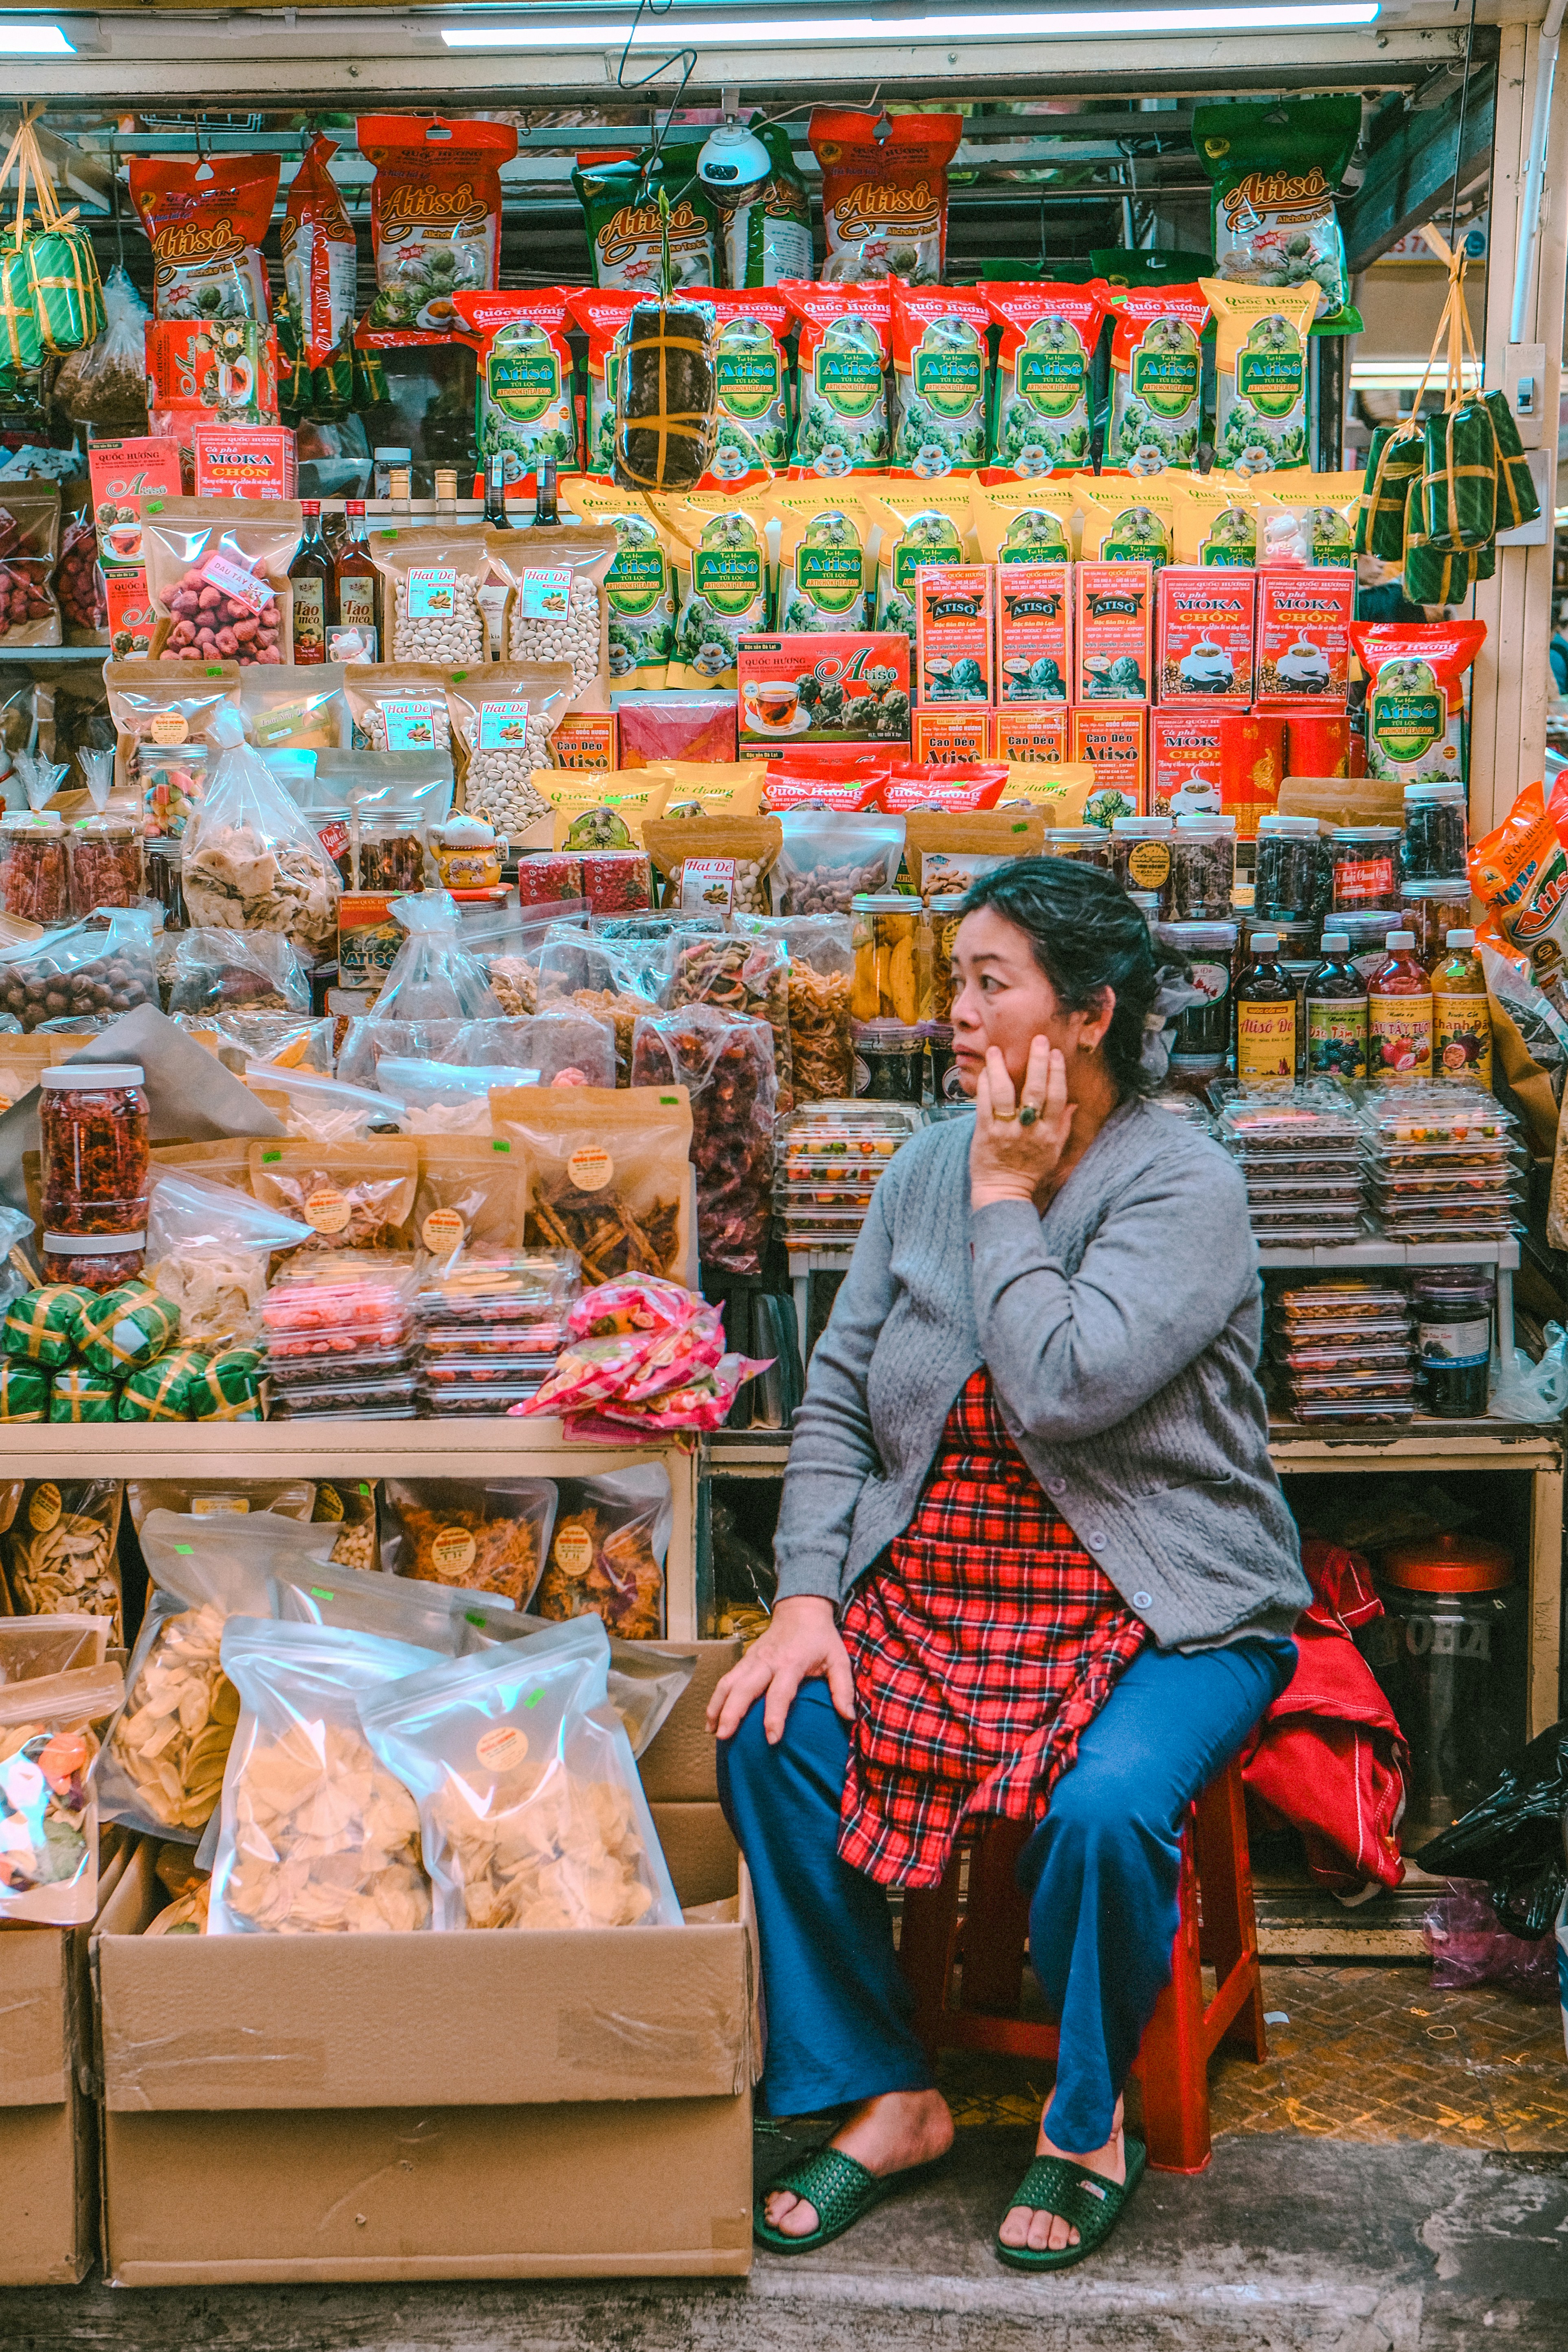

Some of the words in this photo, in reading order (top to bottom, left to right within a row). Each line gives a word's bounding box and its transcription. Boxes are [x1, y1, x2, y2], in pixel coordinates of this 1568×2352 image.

[1224, 167, 1331, 209] Atisô
[380, 183, 488, 222] Atisô
[835, 180, 939, 222] Atisô
[152, 219, 246, 261] Atisô
[1001, 302, 1040, 312] Quốc
[1044, 302, 1091, 312] Hương
[1225, 296, 1262, 305] Quốc
[1265, 296, 1310, 305] Hương
[473, 309, 511, 320] Quốc
[516, 307, 566, 317] Hương
[738, 305, 786, 314] Hương
[804, 303, 842, 313] Quốc
[1123, 301, 1161, 311] Quốc
[1165, 302, 1206, 314] Hương
[494, 365, 553, 381] Atisô
[718, 362, 775, 377] Atisô
[823, 361, 881, 375] Atisô
[922, 361, 979, 376] Atisô
[1024, 361, 1082, 376] Atisô
[1141, 361, 1196, 377] Atisô
[1245, 361, 1301, 377] Atisô
[99, 452, 122, 461] QUỐC
[127, 451, 159, 459] HƯƠNG
[220, 446, 237, 454] phê
[207, 453, 275, 465] MOKA
[212, 465, 270, 477] CHỒN
[106, 472, 167, 498] Atisô
[782, 498, 819, 507] Quốc
[609, 560, 661, 575] Atisô
[701, 558, 758, 575] Atisô
[804, 556, 860, 571] Atisô
[214, 562, 231, 576] DÂU
[231, 572, 247, 585] TÂY
[412, 571, 435, 582] Hạt
[437, 570, 455, 580] Dẻ
[527, 571, 550, 582] Hạt
[553, 572, 570, 582] Dẻ
[114, 582, 140, 591] QUỐC
[294, 600, 319, 616] Táo
[343, 600, 370, 616] Táo
[935, 603, 975, 617] ATISÔ
[1013, 602, 1053, 615] ATISÔ
[1095, 601, 1134, 613] ATISÔ
[1175, 599, 1244, 610] MOKA
[1274, 598, 1343, 611] MOKA
[299, 614, 319, 624] mèo
[349, 614, 370, 624] mèo
[1179, 610, 1239, 621] CHỒN
[1278, 610, 1337, 622] CHỒN
[1364, 643, 1401, 652] Quốc
[1406, 643, 1458, 652] Hương
[745, 657, 771, 665] QUỐC
[814, 647, 898, 683] Atisô
[386, 704, 410, 714] Hạt
[414, 703, 430, 713] Dẻ
[484, 704, 507, 714] Hạt
[511, 703, 527, 713] Dẻ
[1377, 703, 1437, 720] Atisô
[929, 738, 950, 747] Cao
[953, 737, 975, 747] Dẻo
[1008, 736, 1028, 744] Cao
[1032, 735, 1054, 744] Dẻo
[1086, 733, 1107, 743] Cao
[1111, 733, 1133, 743] Dẻo
[557, 741, 577, 751] Cao
[582, 741, 602, 751] Dẻo
[925, 749, 981, 764] Atisô
[1005, 748, 1061, 763] Atisô
[1081, 746, 1139, 760] Atisô
[766, 785, 805, 797] Quốc
[884, 786, 921, 798] Quốc
[929, 790, 981, 802] Hương
[1512, 870, 1568, 935] Atis
[1241, 1018, 1274, 1033] Atisô
[1388, 1019, 1410, 1035] TÂY
[1412, 1019, 1430, 1034] TƯƠ
[1433, 1018, 1469, 1030] Chanh
